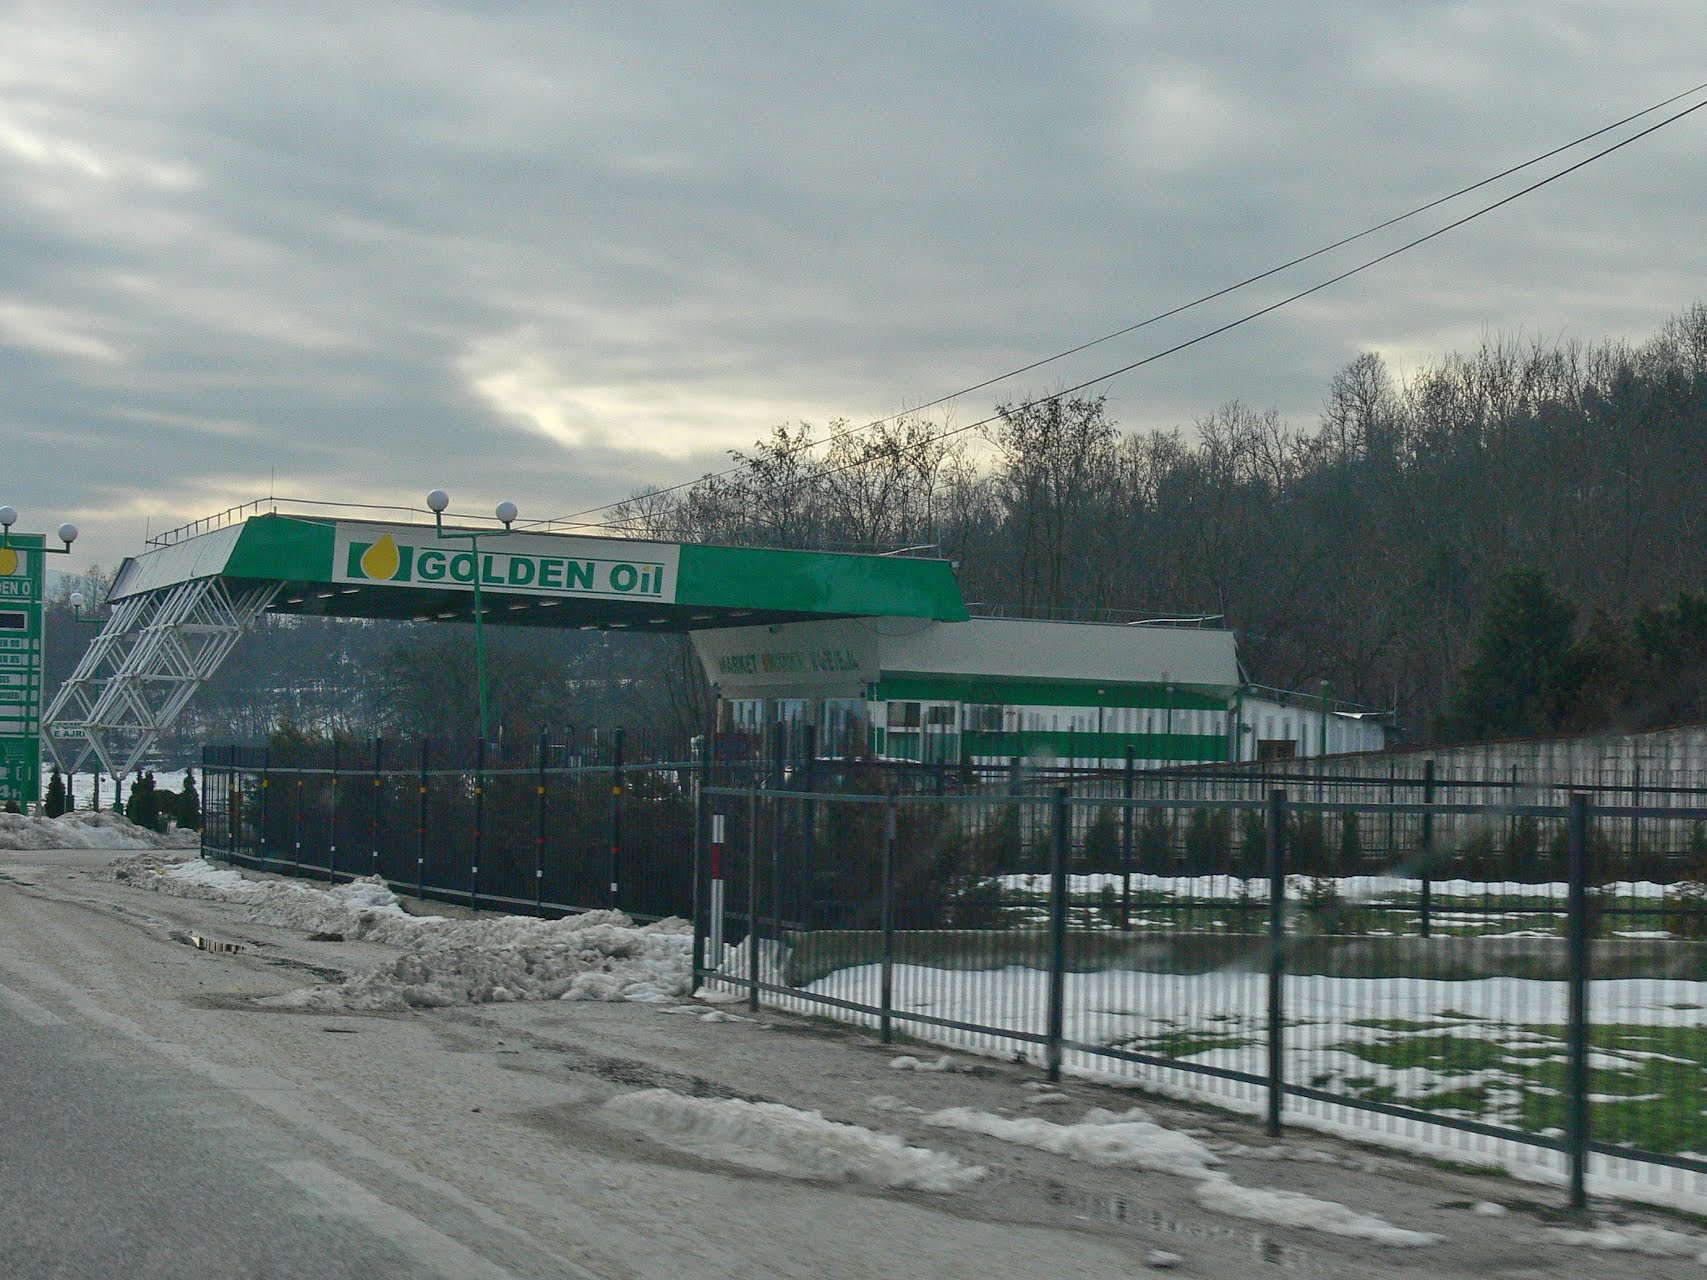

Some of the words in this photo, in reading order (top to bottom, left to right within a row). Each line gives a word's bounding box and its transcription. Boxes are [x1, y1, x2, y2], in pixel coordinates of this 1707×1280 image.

[417, 551, 595, 590] GOLDEN
[609, 564, 663, 594] Oil
[718, 653, 759, 674] MARKET
